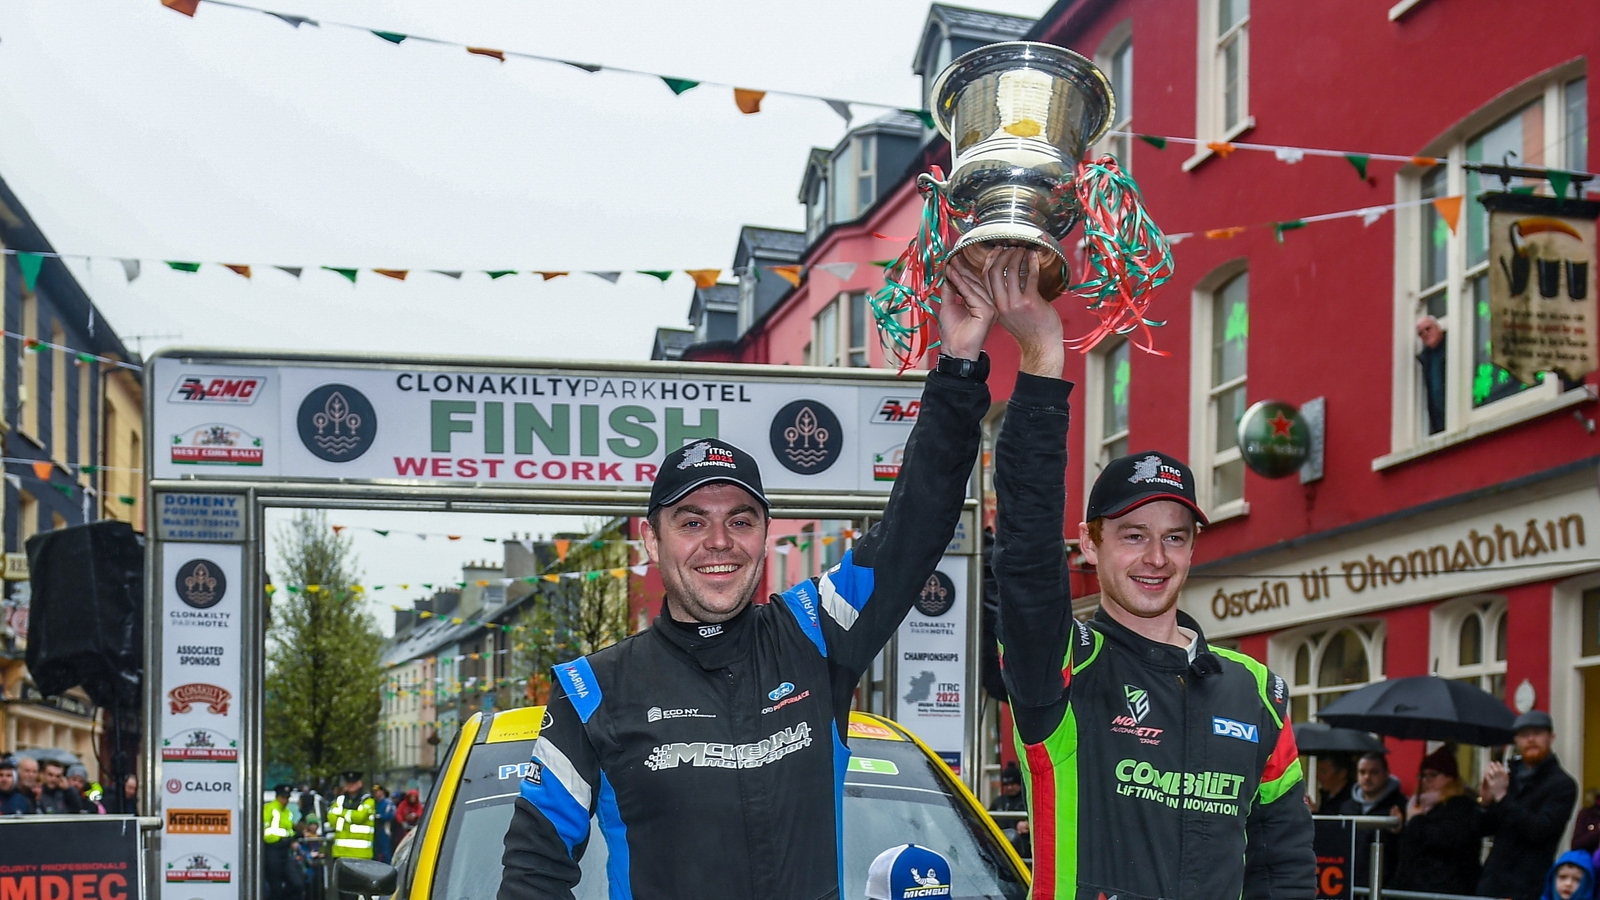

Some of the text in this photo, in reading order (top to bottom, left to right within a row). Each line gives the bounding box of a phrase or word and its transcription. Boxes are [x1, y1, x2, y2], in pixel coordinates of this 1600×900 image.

[206, 378, 257, 398] CMC
[396, 373, 752, 403] CLONAKILTYPARKHOTEL
[430, 399, 720, 460] FINISH
[709, 447, 733, 457] ITRC
[708, 454, 734, 463] 2023
[394, 456, 505, 478] WEST
[514, 459, 624, 482] CORK
[693, 461, 737, 469] WINNERS
[1160, 465, 1181, 477] ITRC
[1145, 478, 1184, 490] WINNERS
[164, 495, 236, 507] DOHENY
[170, 611, 231, 619] CLONAKILTY
[910, 621, 956, 629] CLONAKILTY
[698, 625, 723, 637] OMP
[177, 646, 224, 656] ASSOCIATED
[180, 656, 221, 667] SPONSORS
[904, 652, 959, 662] CHAMPIONSHIPS
[565, 666, 589, 698] MARINA
[938, 683, 960, 692] ITRC
[936, 692, 960, 703] 2023
[1213, 718, 1255, 740] DSV
[859, 760, 876, 770] E
[185, 781, 232, 792] CALOR
[169, 813, 228, 826] Keohane
[41, 862, 127, 871] PROFESSIONALS
[903, 887, 949, 899] MICHELIN
